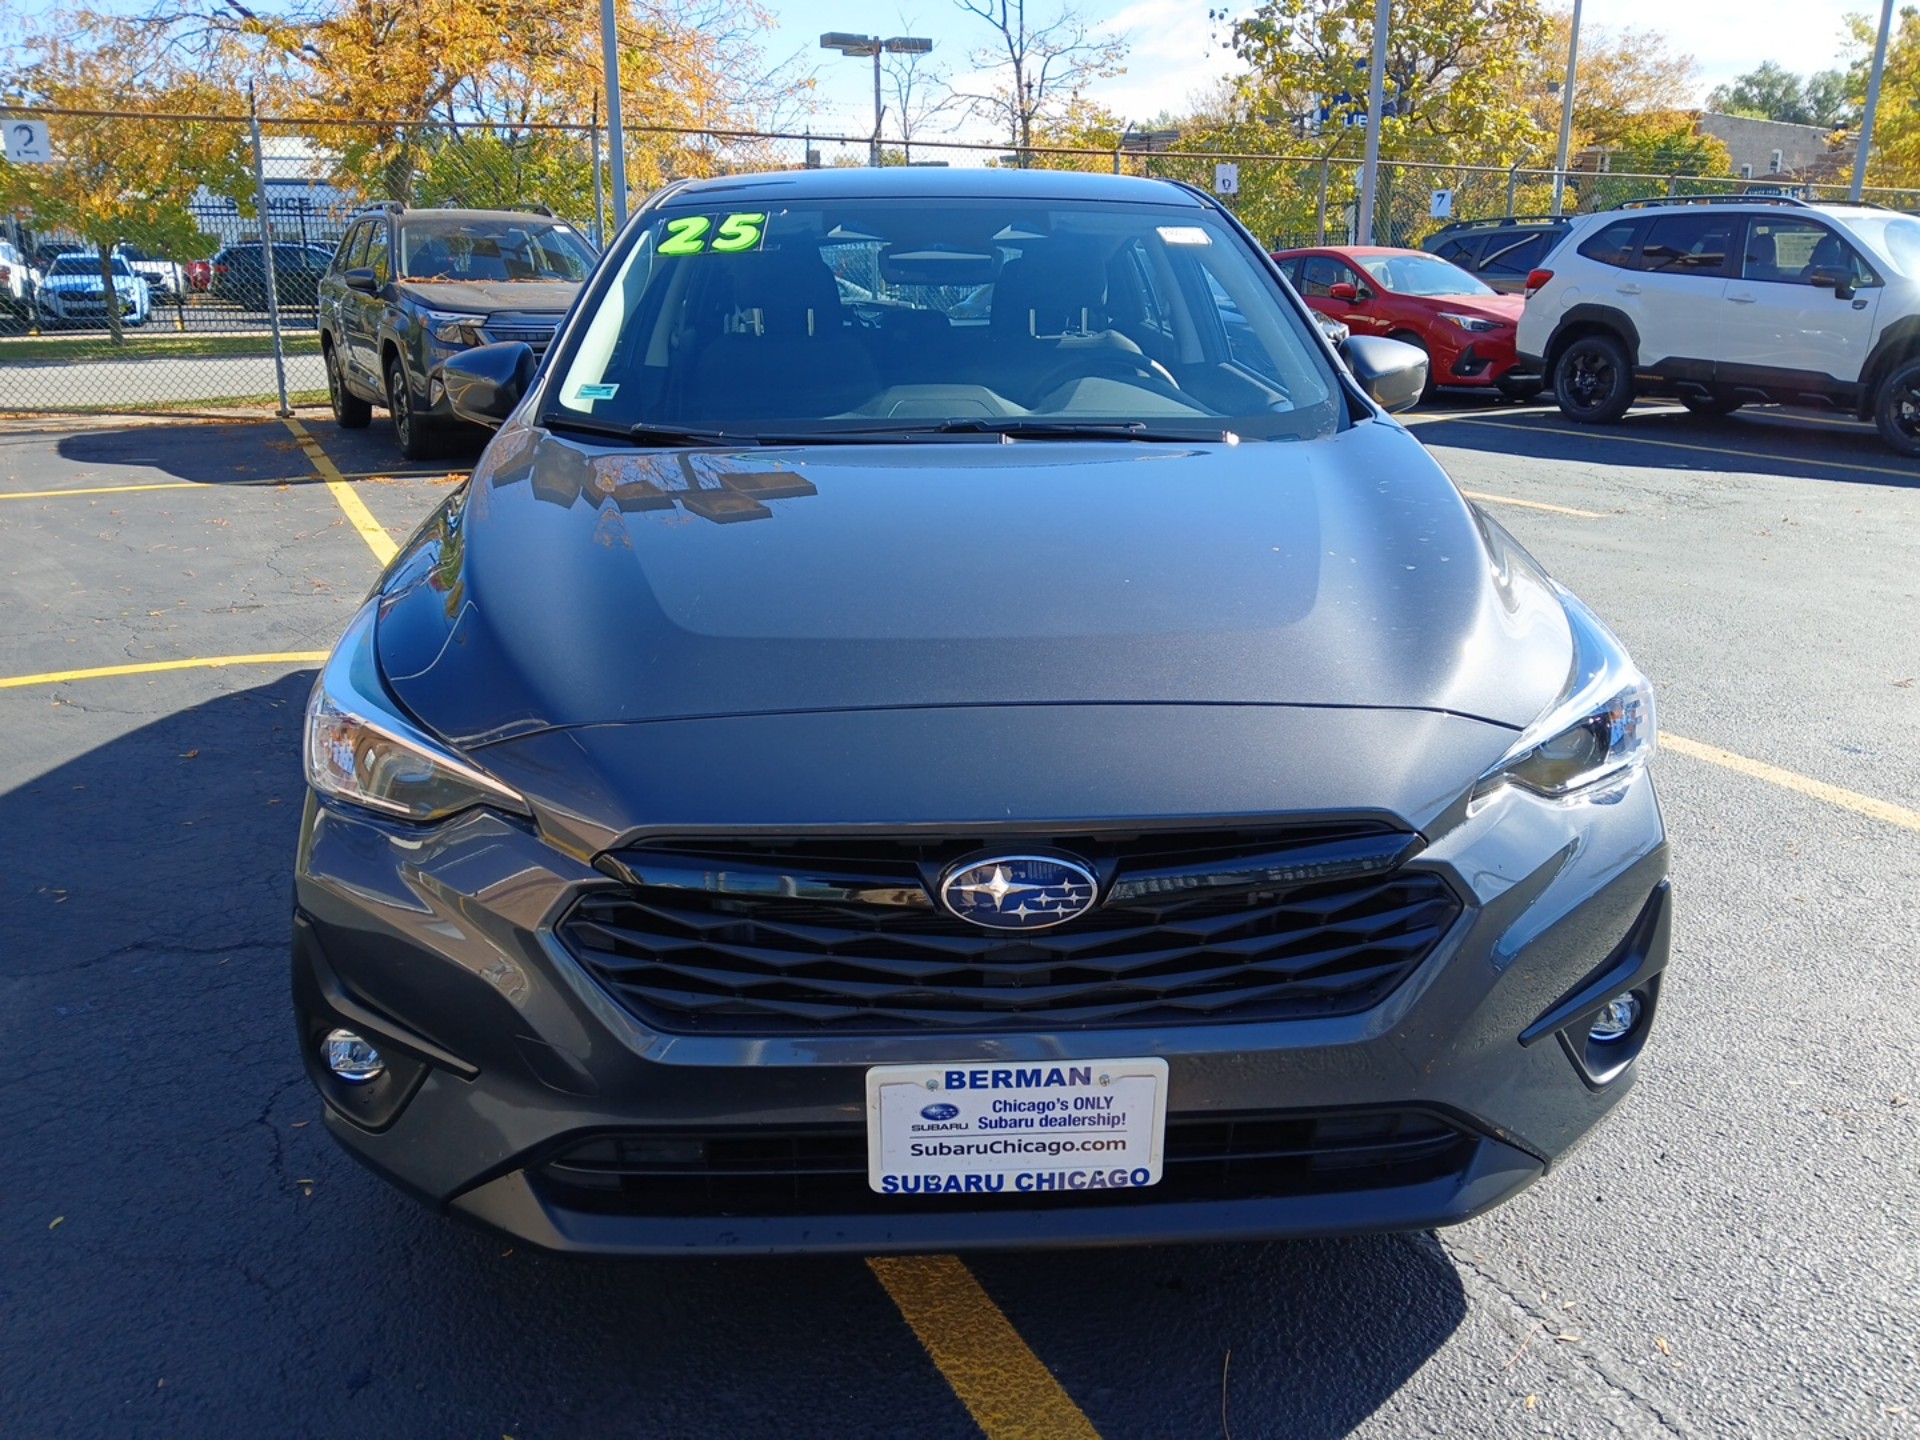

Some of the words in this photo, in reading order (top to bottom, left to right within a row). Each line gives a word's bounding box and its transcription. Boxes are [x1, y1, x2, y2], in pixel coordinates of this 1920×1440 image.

[13, 123, 40, 157] 2
[1436, 193, 1446, 209] 7
[657, 212, 766, 254] 25
[944, 1067, 1092, 1090] BERMAN
[992, 1098, 1069, 1115] Chicago's
[1073, 1096, 1114, 1111] ONLY
[911, 1123, 969, 1132] SUBARU
[978, 1115, 1035, 1130] Subaru
[1039, 1112, 1126, 1128] dealership!
[910, 1138, 1127, 1157] SubaruChicago.com
[881, 1174, 1004, 1194] SUBARU
[1015, 1168, 1150, 1192] CHICAGO
